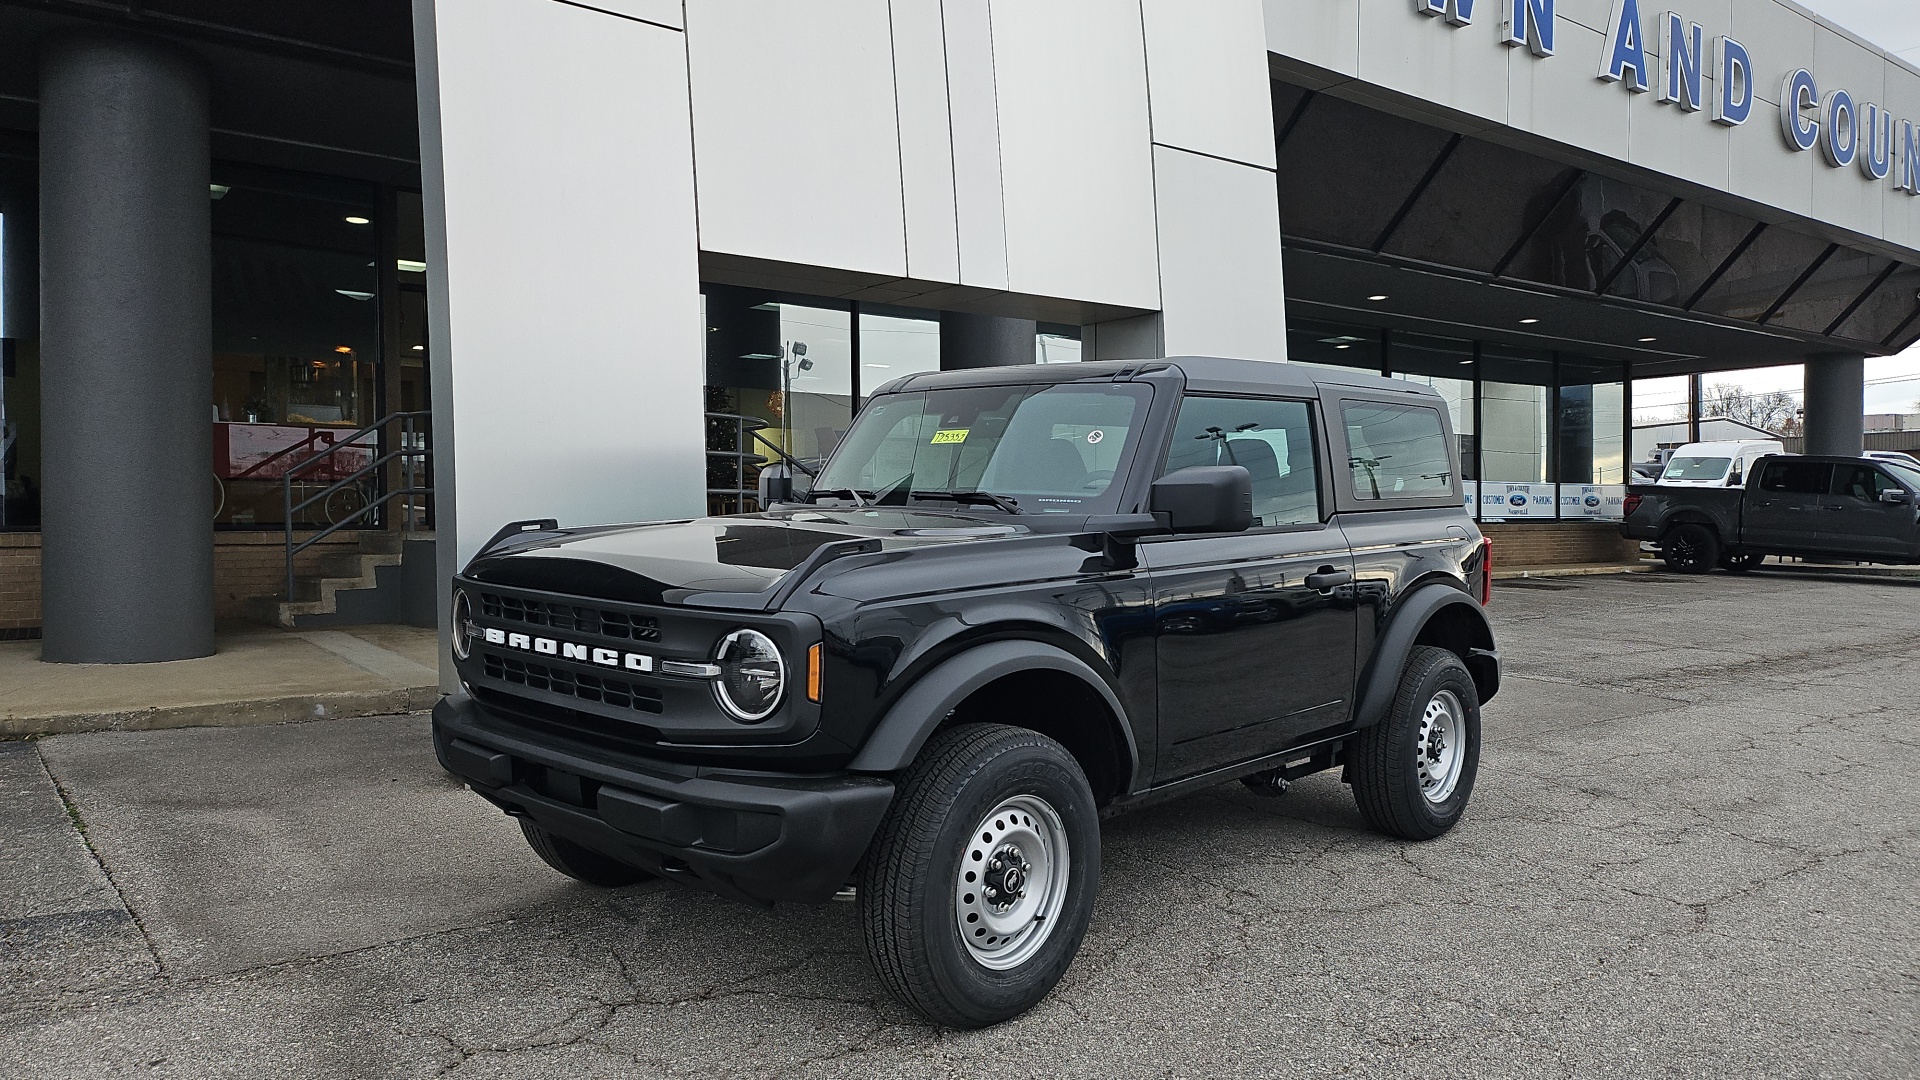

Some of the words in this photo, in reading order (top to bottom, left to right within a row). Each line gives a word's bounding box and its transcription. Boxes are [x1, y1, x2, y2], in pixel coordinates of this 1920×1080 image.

[1598, 0, 1754, 126] AND
[1780, 68, 1920, 195] COUN
[1483, 495, 1505, 504] CUSTOMER
[1533, 496, 1552, 505] PARKING
[1561, 497, 1580, 505] CUSTOMER
[1605, 497, 1623, 505] PARKING
[485, 628, 653, 672] BRONCO
